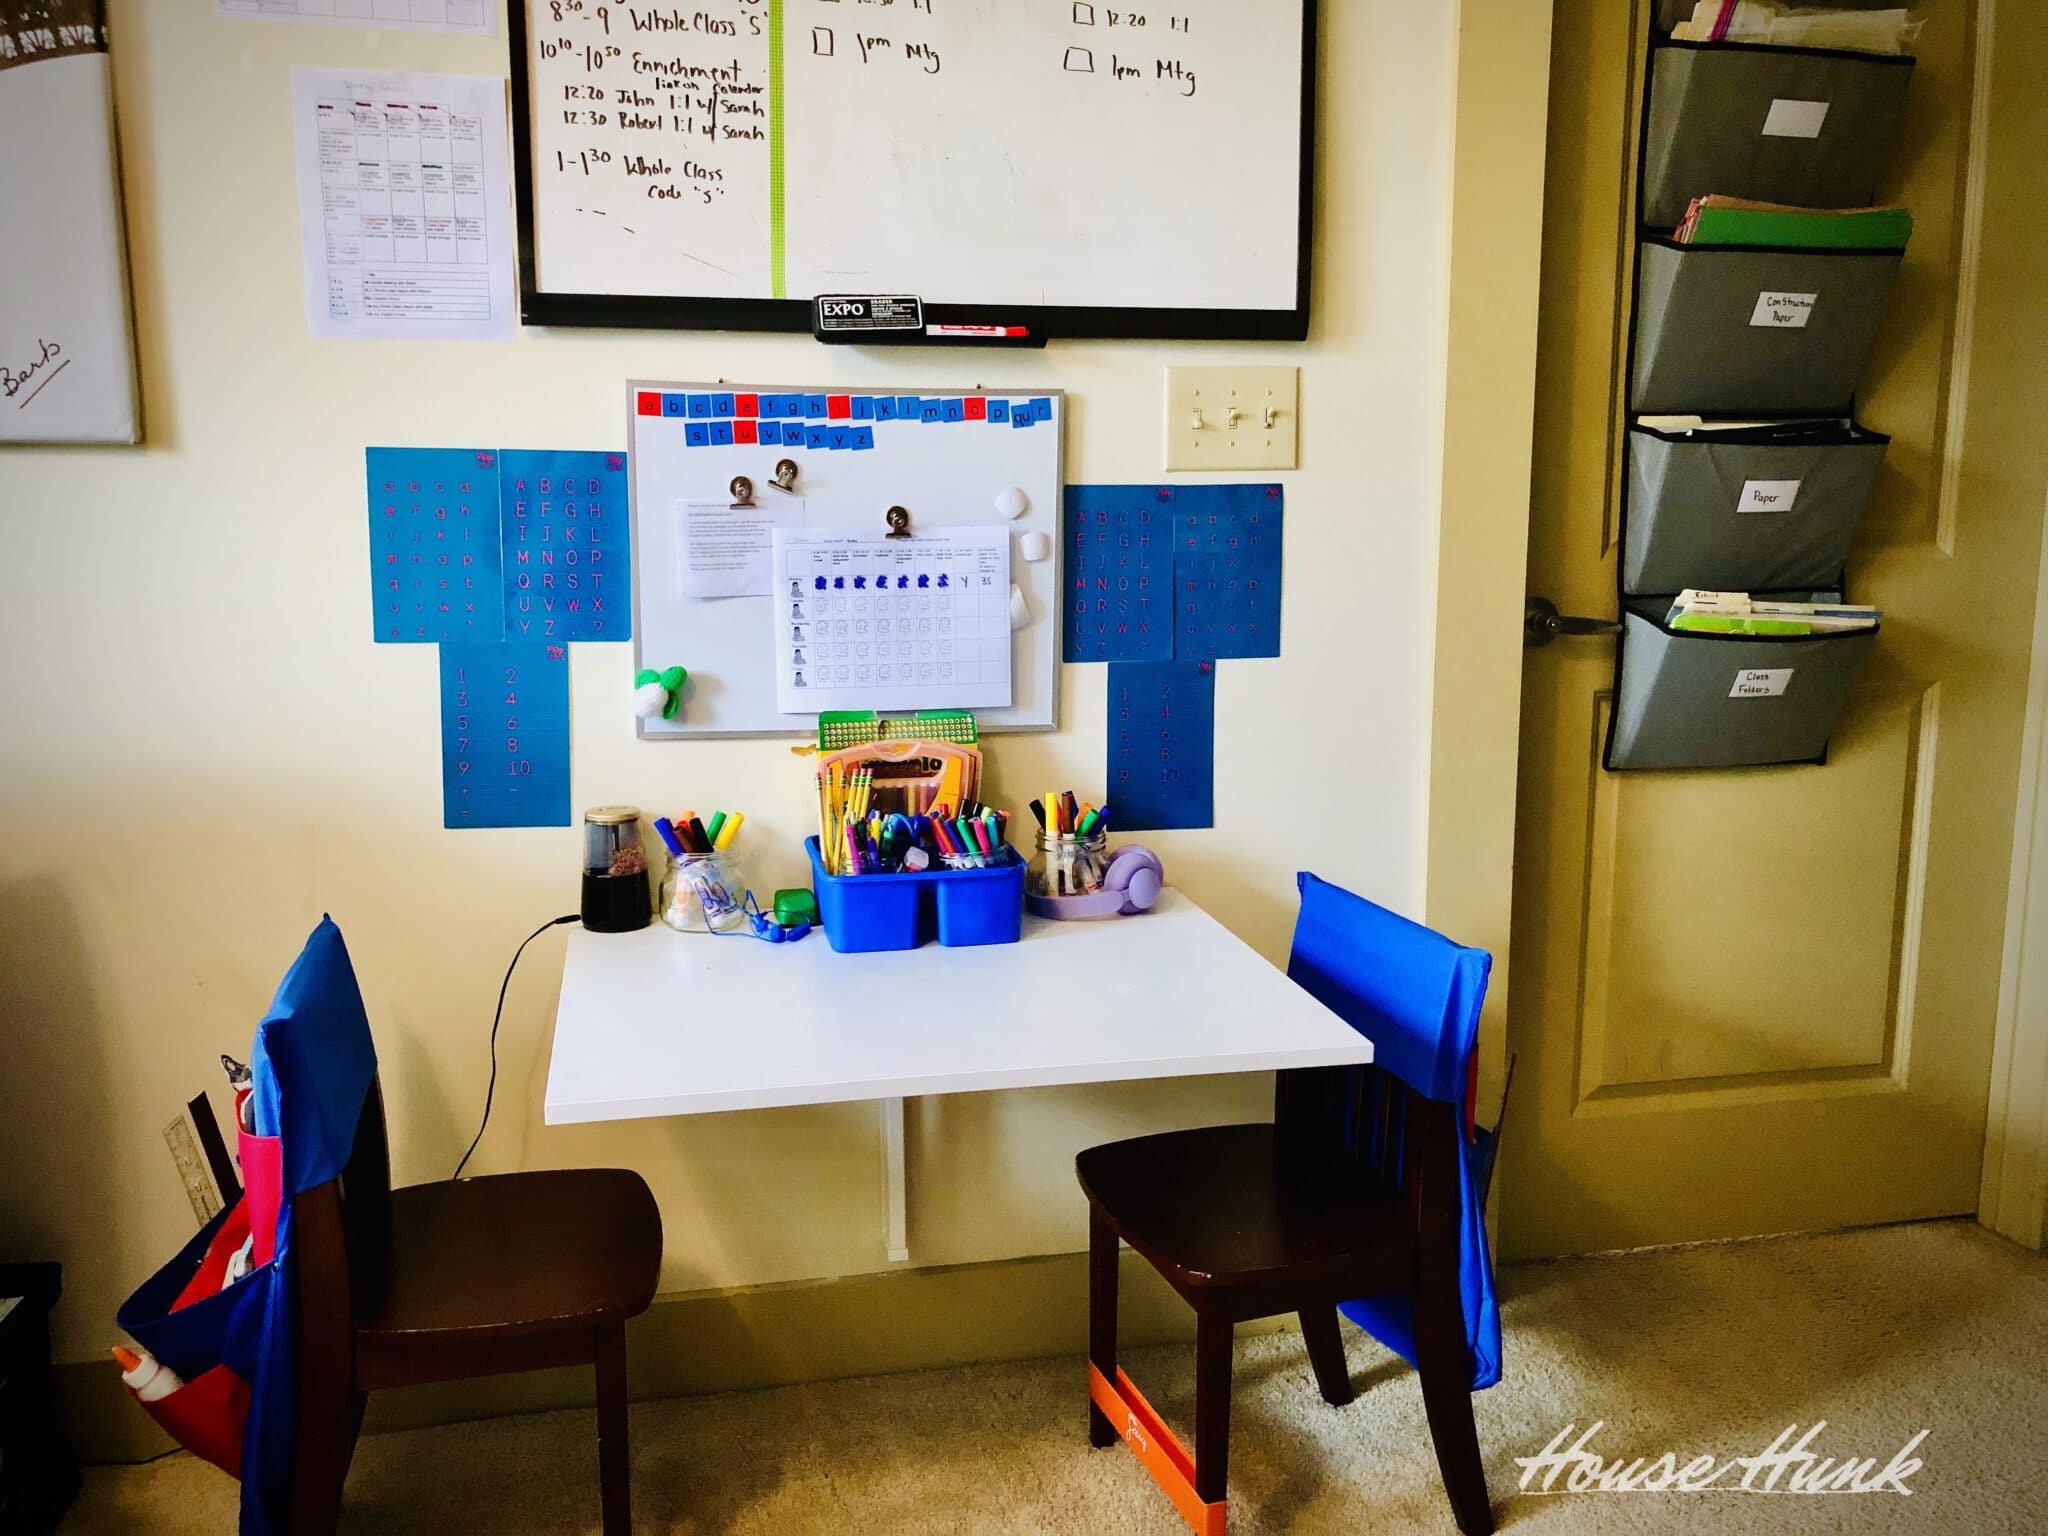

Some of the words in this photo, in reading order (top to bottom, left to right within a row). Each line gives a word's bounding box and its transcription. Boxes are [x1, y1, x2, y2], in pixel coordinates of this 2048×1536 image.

[629, 8, 689, 33] Whole
[694, 12, 737, 36] Class
[1107, 9, 1146, 27] 12:20
[1171, 16, 1189, 33] 1:1
[857, 33, 891, 63] 1pm
[905, 43, 940, 74] Mtg
[632, 52, 742, 83] Enrichment
[1112, 54, 1141, 81] 1pm
[1157, 60, 1195, 97] Mtg
[564, 85, 604, 101] 12:20
[615, 89, 655, 107] John
[670, 94, 689, 110] 1:1
[720, 99, 765, 118] Sarah
[563, 110, 607, 126] 12:30
[619, 112, 662, 131] Robert
[674, 115, 692, 134] 1:1
[722, 125, 765, 141] Sarah
[684, 161, 723, 181] Class
[648, 185, 682, 200] Code
[823, 303, 864, 316] EXPO
[1773, 310, 1795, 323] Paper
[516, 478, 525, 493] A
[540, 477, 551, 494] B
[564, 478, 575, 494] C
[589, 478, 600, 494] D
[1753, 489, 1780, 505] Paper
[516, 501, 526, 517] E
[541, 501, 551, 517] F
[565, 502, 576, 518] G
[589, 503, 600, 518] H
[519, 525, 526, 541] I
[542, 525, 550, 541] J
[565, 526, 576, 541] K
[591, 527, 600, 542] L
[518, 550, 528, 564] M
[542, 550, 553, 565] N
[566, 549, 578, 565] O
[591, 549, 601, 564] P
[518, 573, 530, 589] Q
[543, 573, 554, 588] R
[567, 573, 578, 589] S
[592, 573, 602, 588] T
[519, 596, 530, 612] U
[543, 596, 554, 612] V
[568, 598, 579, 612] W
[592, 597, 603, 612] X
[520, 620, 530, 634] Y
[544, 619, 554, 636] Z
[457, 668, 465, 685] 1
[506, 668, 516, 684] 2
[1739, 684, 1770, 694] Folders
[457, 691, 467, 707] 3
[506, 692, 516, 705] 4
[457, 715, 468, 730] 5
[507, 715, 517, 730] 6
[458, 737, 468, 753] 7
[506, 737, 518, 753] 8
[458, 761, 469, 776] 9
[509, 760, 530, 776] 10
